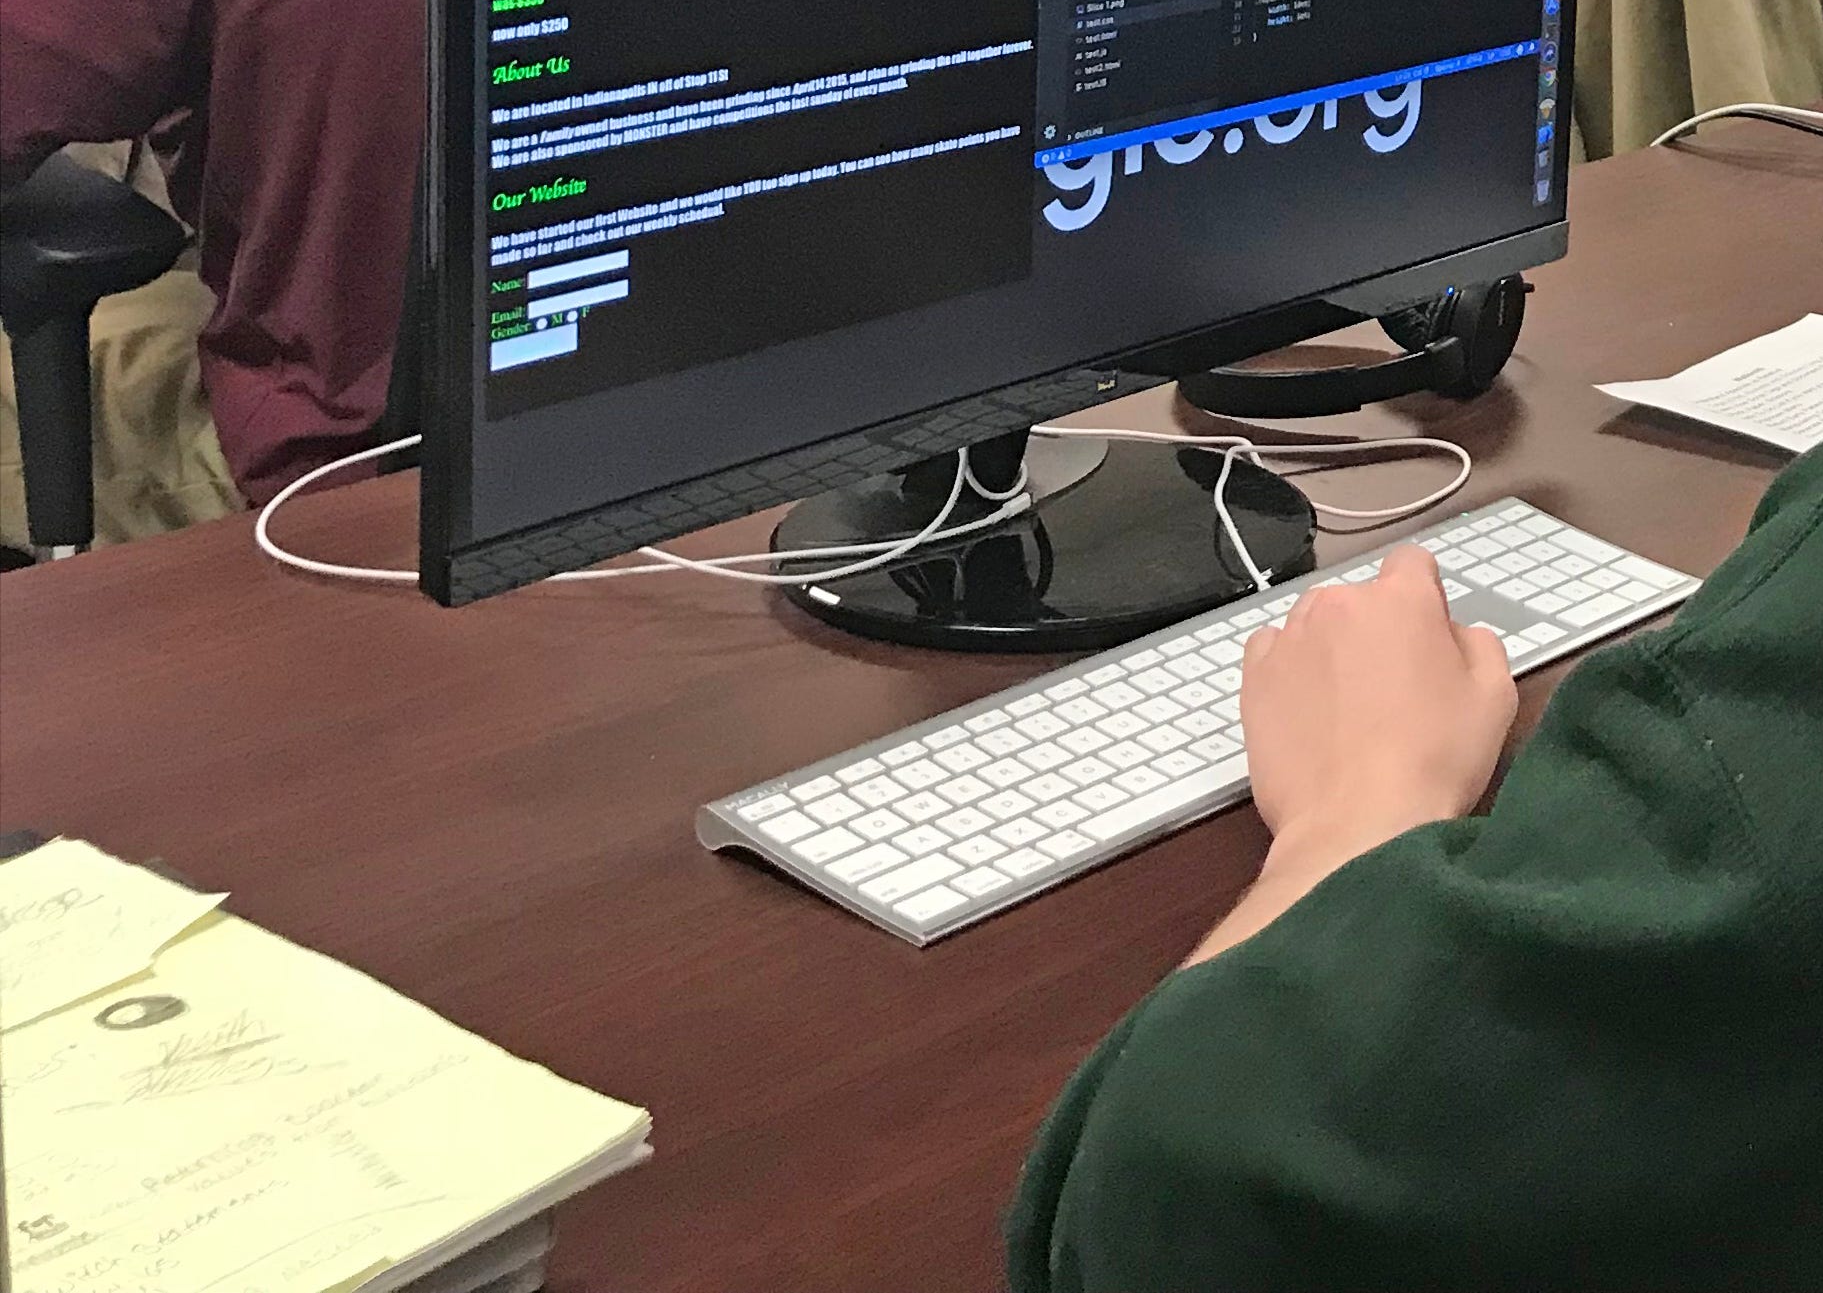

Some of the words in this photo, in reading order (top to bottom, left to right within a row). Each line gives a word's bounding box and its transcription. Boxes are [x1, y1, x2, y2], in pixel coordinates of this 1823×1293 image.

[492, 29, 516, 41] now
[517, 22, 540, 37] only
[542, 17, 569, 33] $250
[493, 60, 543, 84] About
[547, 56, 570, 74] Us
[491, 108, 510, 123] We
[511, 106, 528, 119] are
[531, 96, 570, 116] located
[572, 95, 582, 108] in
[583, 84, 645, 106] Indianapolis
[647, 81, 657, 94] IN
[673, 76, 683, 89] of
[684, 74, 706, 87] Stop
[492, 192, 526, 211] Our
[530, 177, 587, 204] Website
[523, 246, 536, 258] so
[537, 242, 552, 255] far
[553, 235, 573, 252] and
[574, 229, 605, 247] check
[607, 225, 623, 239] out
[625, 222, 641, 235] our
[643, 214, 677, 231] weekly
